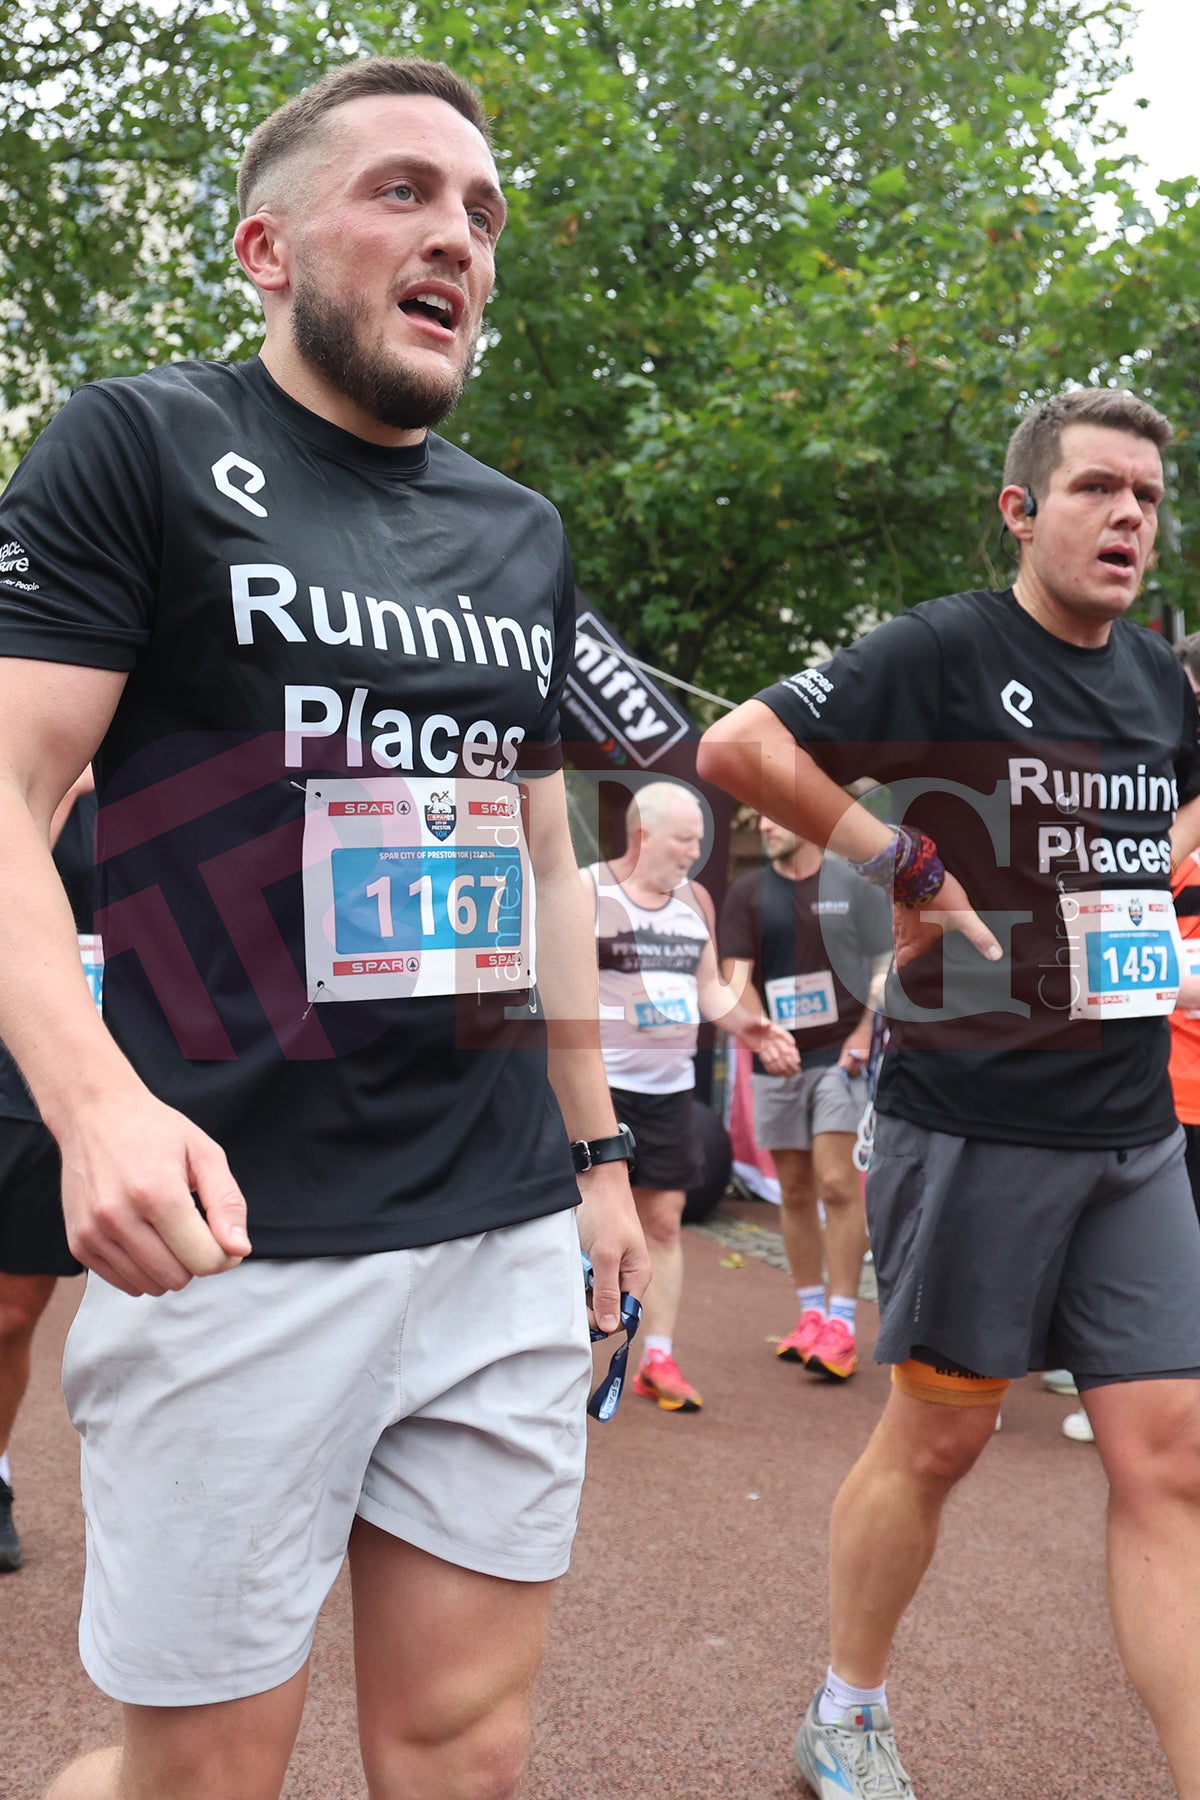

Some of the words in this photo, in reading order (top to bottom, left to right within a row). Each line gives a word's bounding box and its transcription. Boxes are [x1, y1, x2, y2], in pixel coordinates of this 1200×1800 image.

[229, 563, 554, 699] Running
[284, 684, 525, 780] Places
[344, 802, 394, 814] SPAR
[379, 852, 399, 860] SPAR
[400, 852, 416, 860] CITY
[416, 851, 427, 859] OF
[427, 851, 457, 859] PRESTON
[1038, 825, 1172, 875] Places
[366, 875, 507, 938] 1167
[352, 960, 403, 973] SPAR
[1102, 946, 1168, 984] 1457
